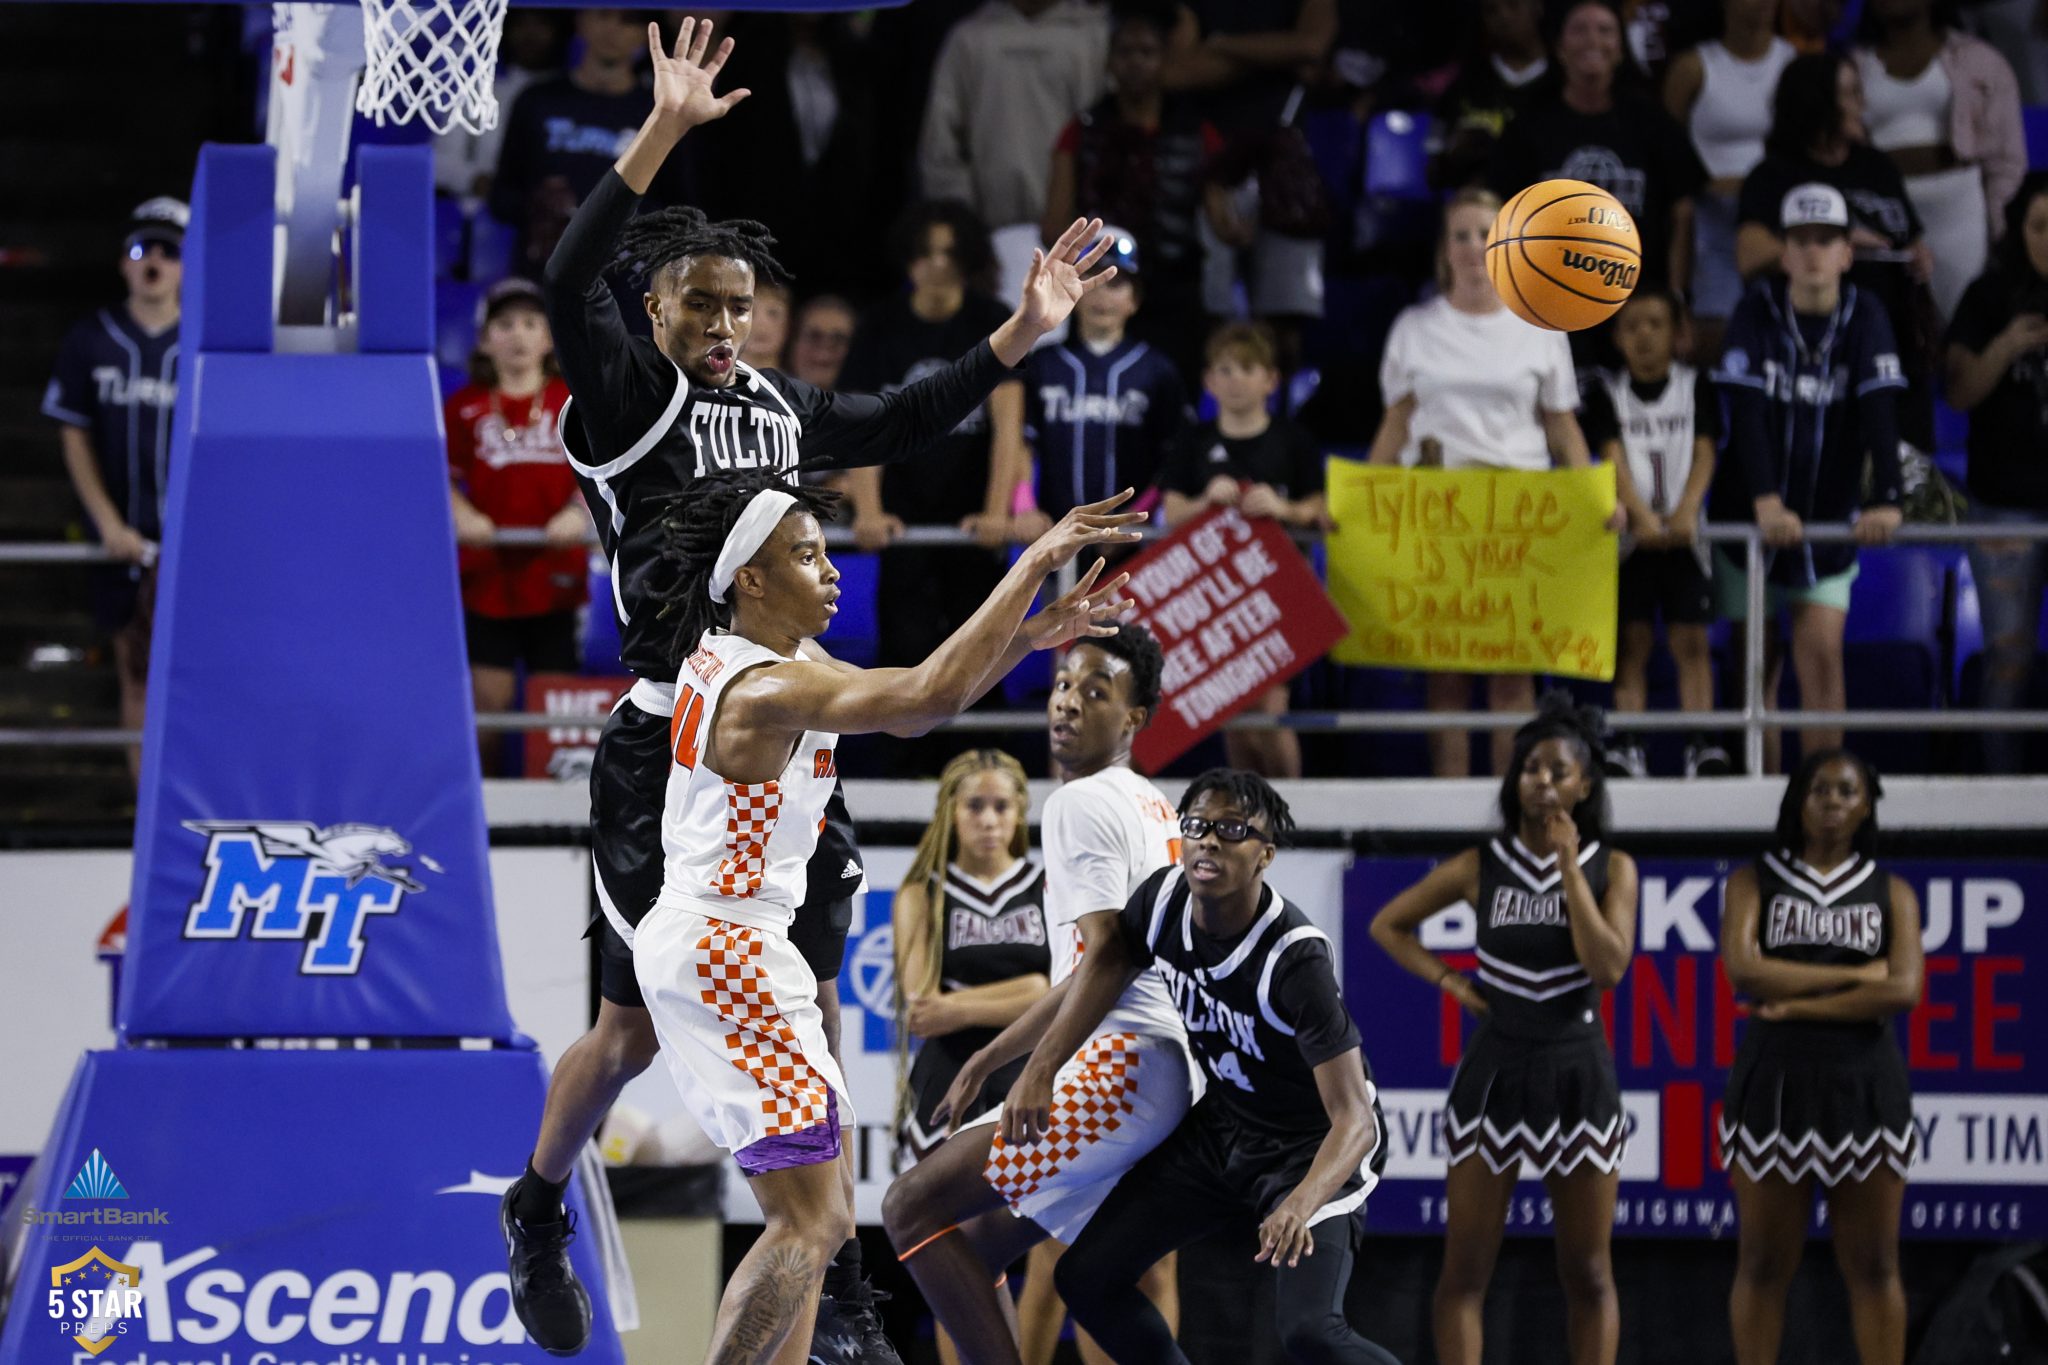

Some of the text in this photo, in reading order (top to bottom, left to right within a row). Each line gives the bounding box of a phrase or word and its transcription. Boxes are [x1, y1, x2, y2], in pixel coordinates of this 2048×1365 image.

[690, 401, 800, 487] FULTON
[1129, 543, 1201, 607] YOUR
[1231, 539, 1278, 586] BE
[1160, 638, 1209, 694] REE
[1198, 590, 1282, 663] AFTER
[841, 867, 863, 879] adidas
[184, 831, 404, 975] MT
[1489, 886, 1571, 928] FALCON
[1766, 894, 1882, 955] FALCONS
[1957, 1113, 2043, 1164] TIM
[1614, 1199, 2022, 1230] HIGHWA OFFICE
